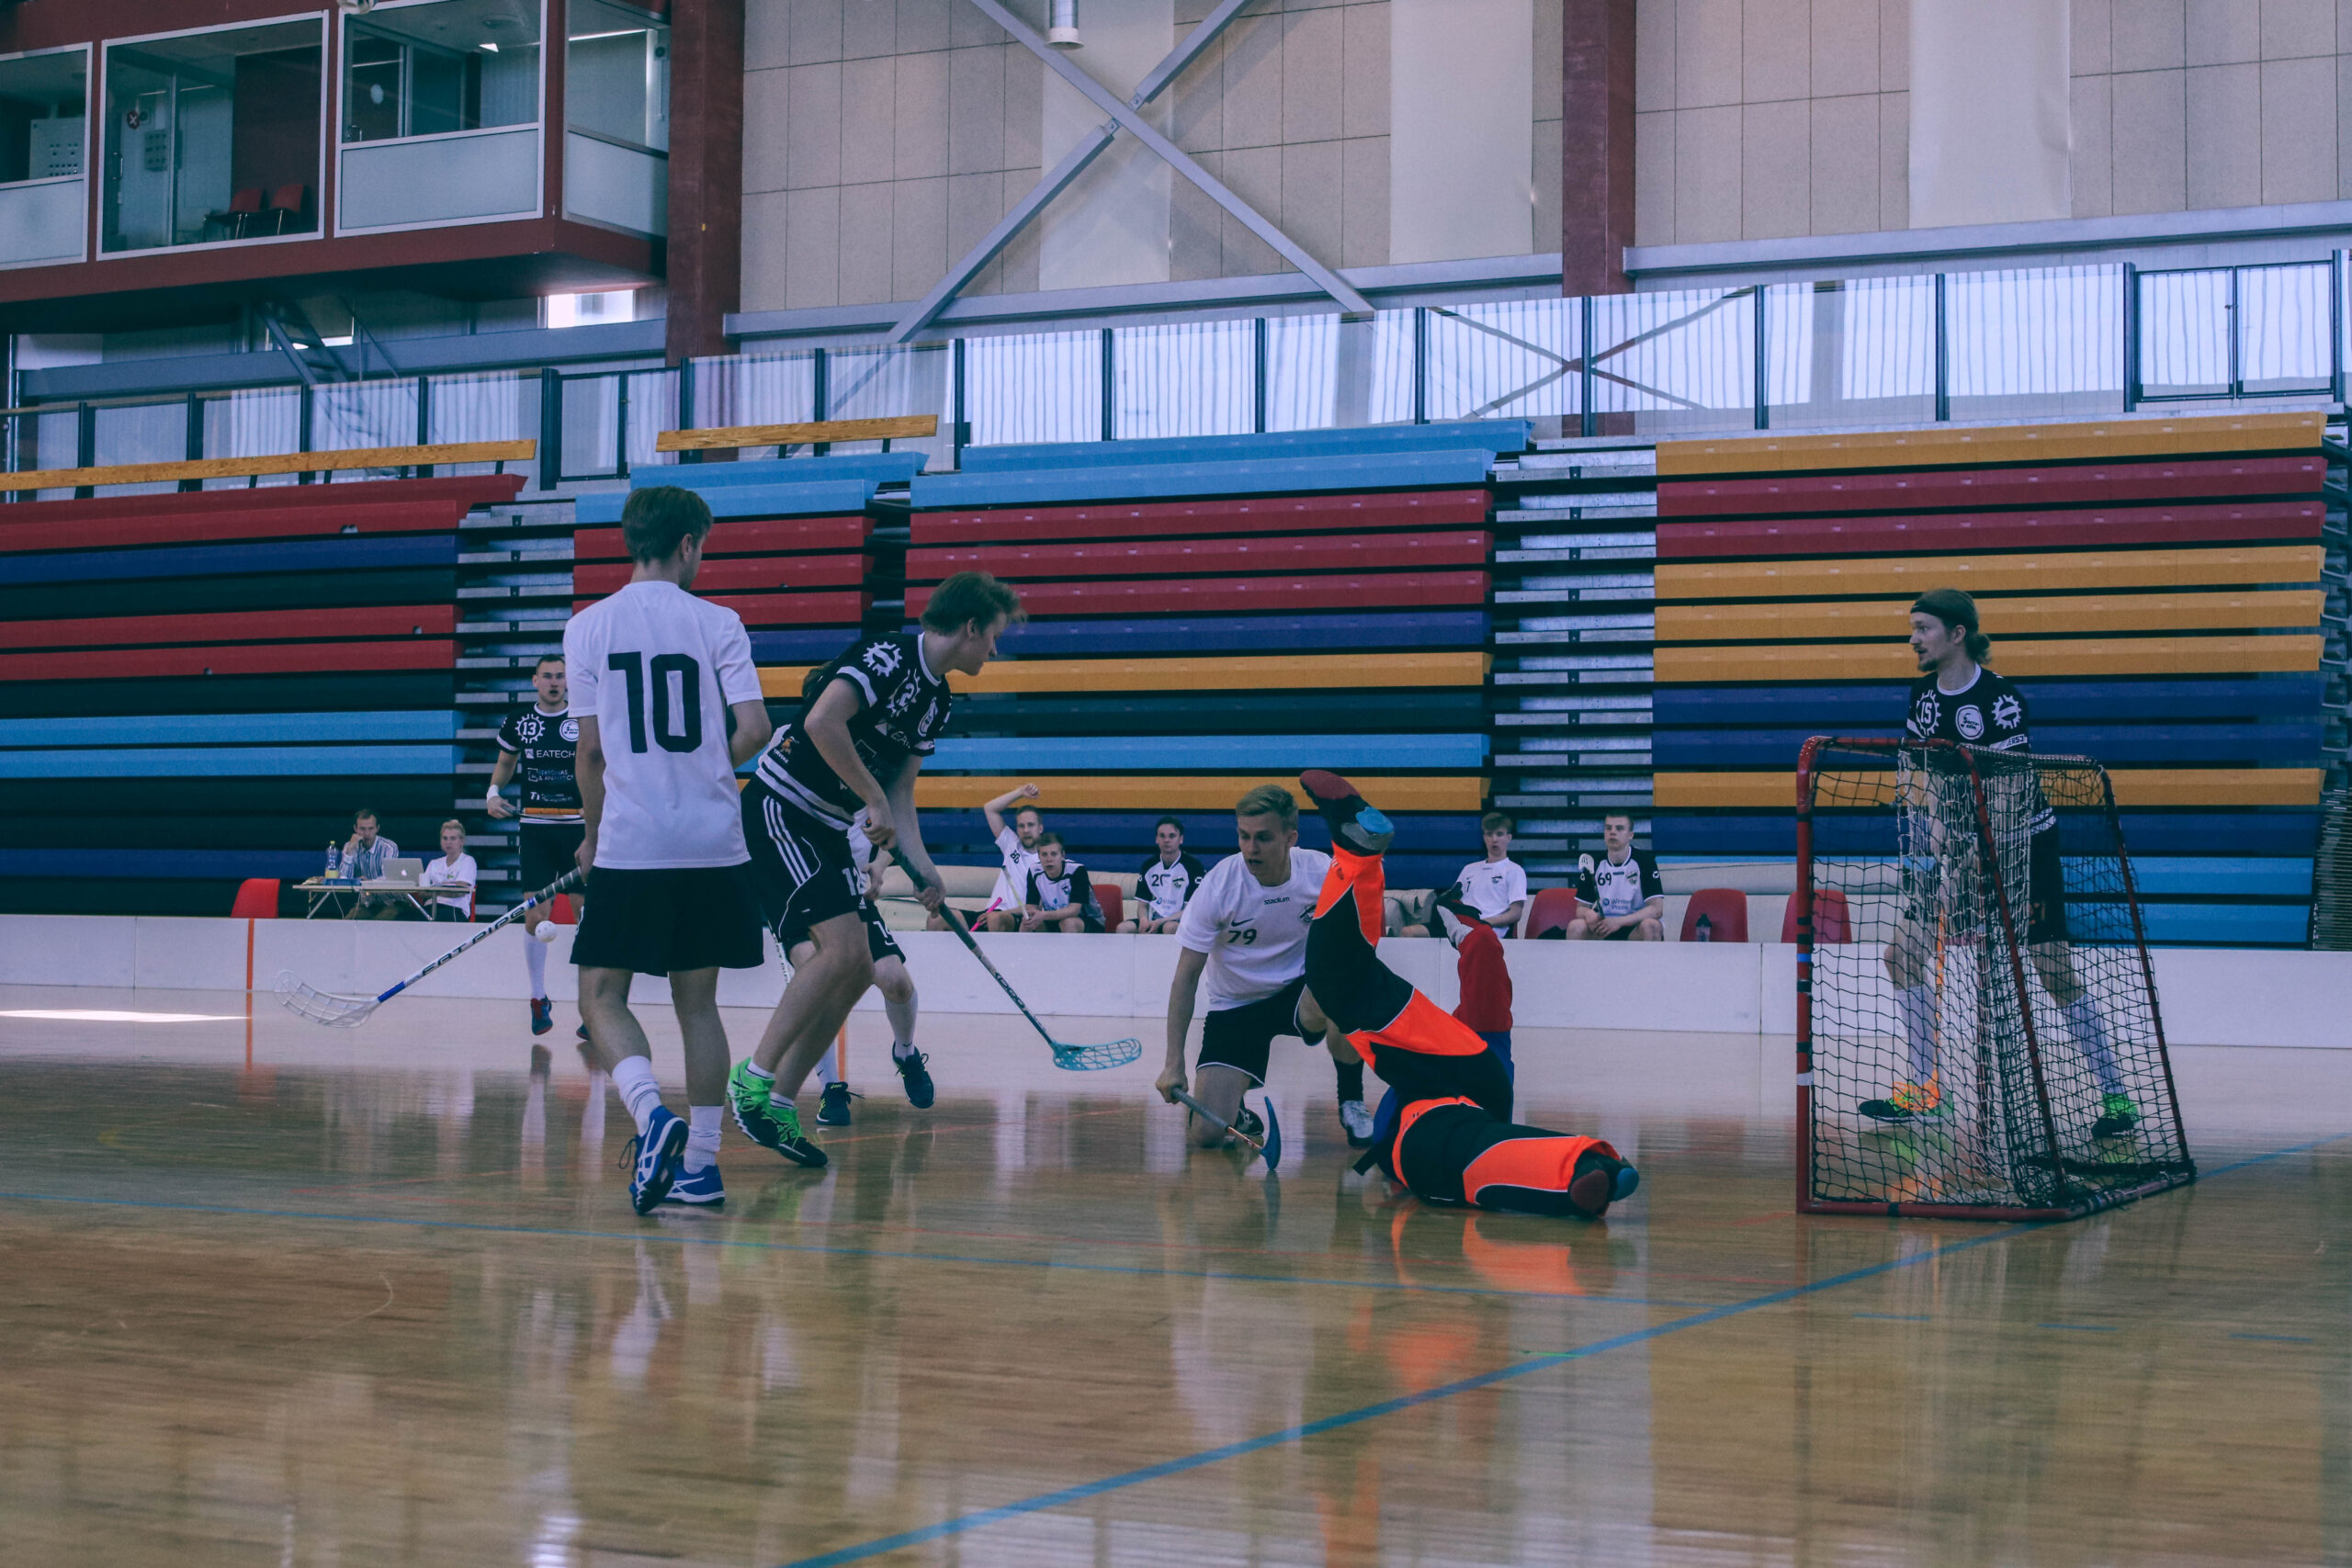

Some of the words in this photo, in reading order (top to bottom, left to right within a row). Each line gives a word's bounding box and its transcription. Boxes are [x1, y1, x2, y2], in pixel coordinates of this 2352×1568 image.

[608, 651, 702, 753] 10
[899, 682, 915, 707] 2
[1920, 701, 1933, 724] 15
[522, 721, 537, 736] 13
[536, 750, 576, 759] EATECH
[1597, 872, 1612, 886] 69
[1263, 897, 1291, 906] stadium
[1227, 928, 1258, 945] 79
